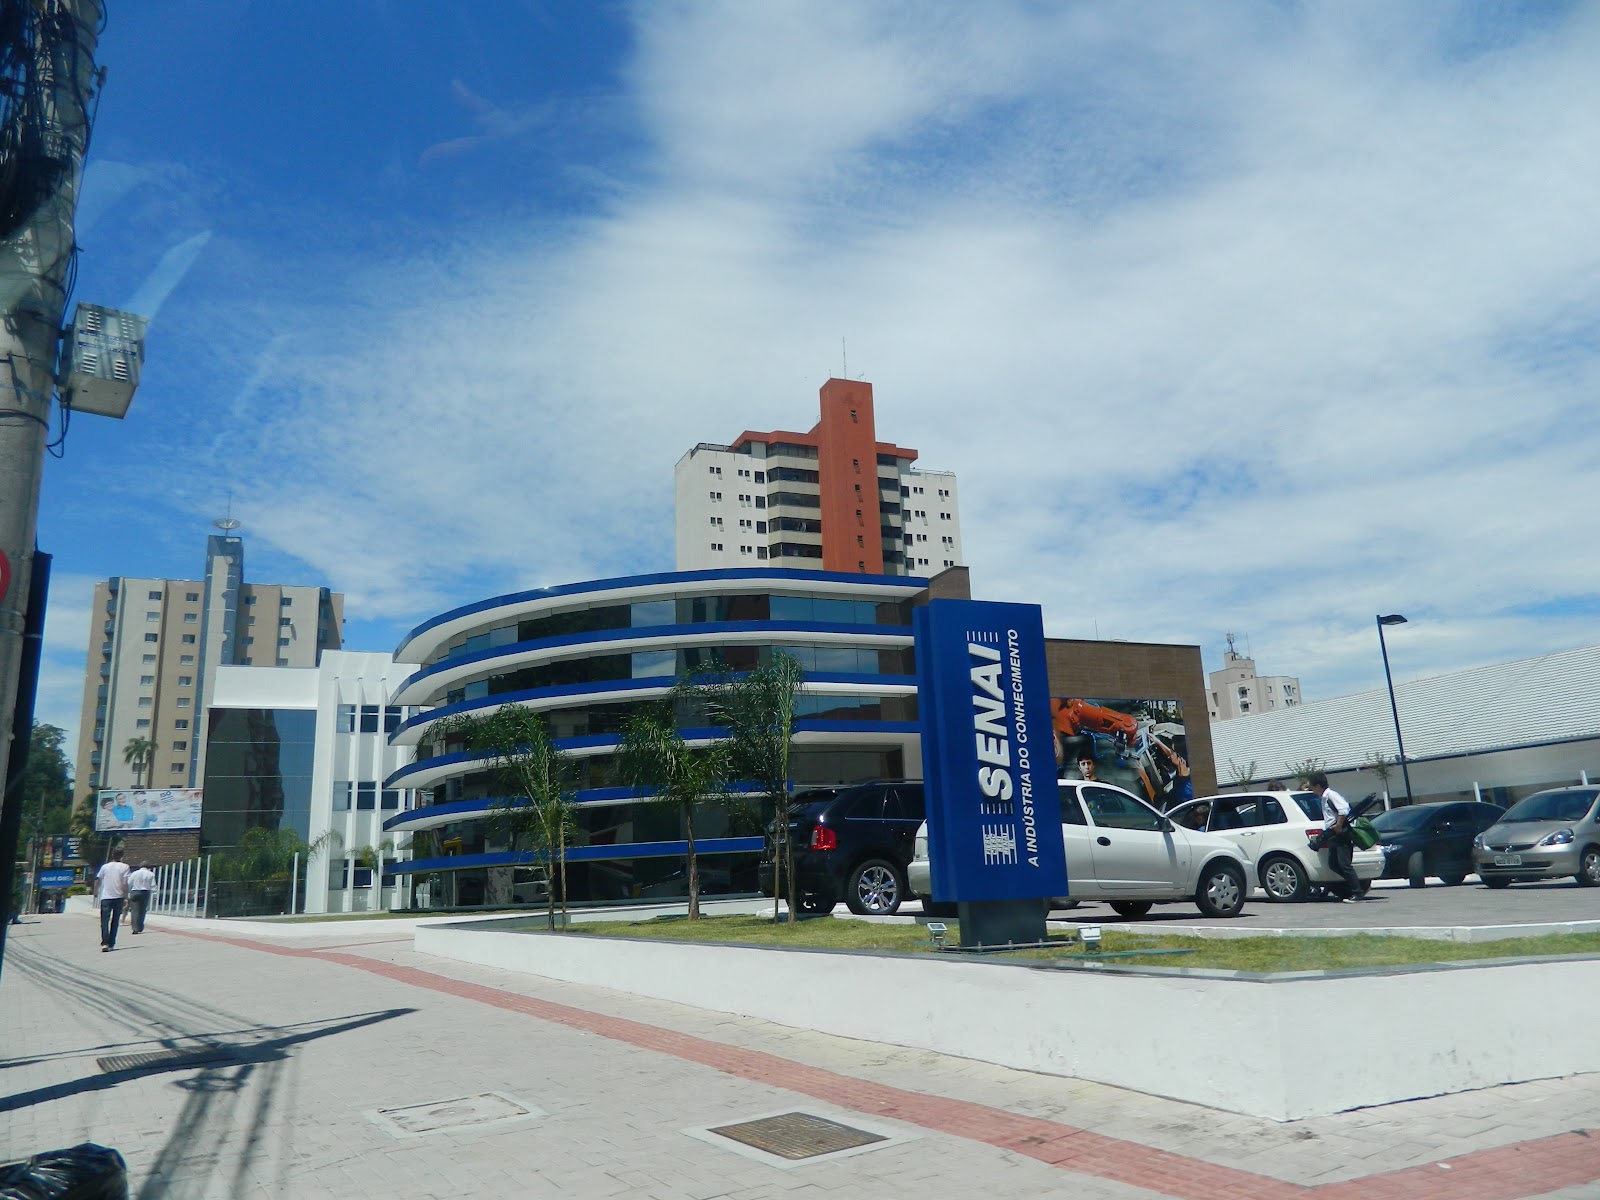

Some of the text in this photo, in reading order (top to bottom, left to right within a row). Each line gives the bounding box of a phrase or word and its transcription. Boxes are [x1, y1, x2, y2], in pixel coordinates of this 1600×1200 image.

[968, 643, 1013, 800] SENAI
[1007, 629, 1040, 867] A INDÚSTRIA DO CONHECIMENTO
